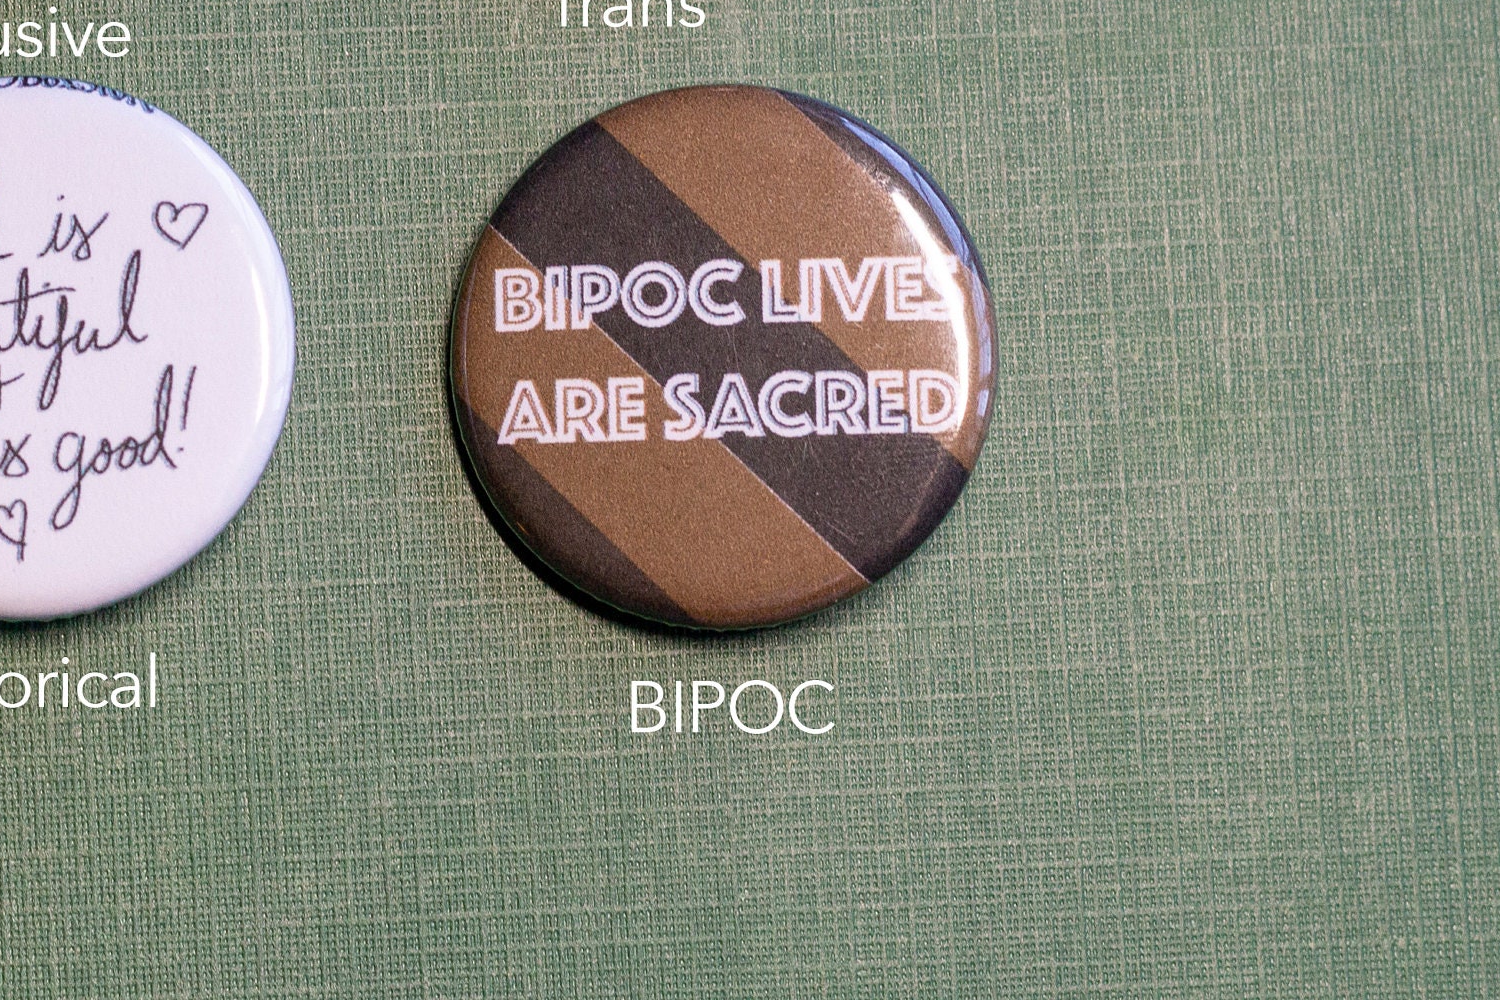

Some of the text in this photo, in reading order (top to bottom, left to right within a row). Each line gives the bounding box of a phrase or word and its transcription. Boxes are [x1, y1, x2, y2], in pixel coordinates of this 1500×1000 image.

[37, 194, 109, 262] is
[494, 256, 959, 333] BIPOC LIVES
[496, 369, 961, 445] ARE SACRED
[50, 363, 198, 531] good!
